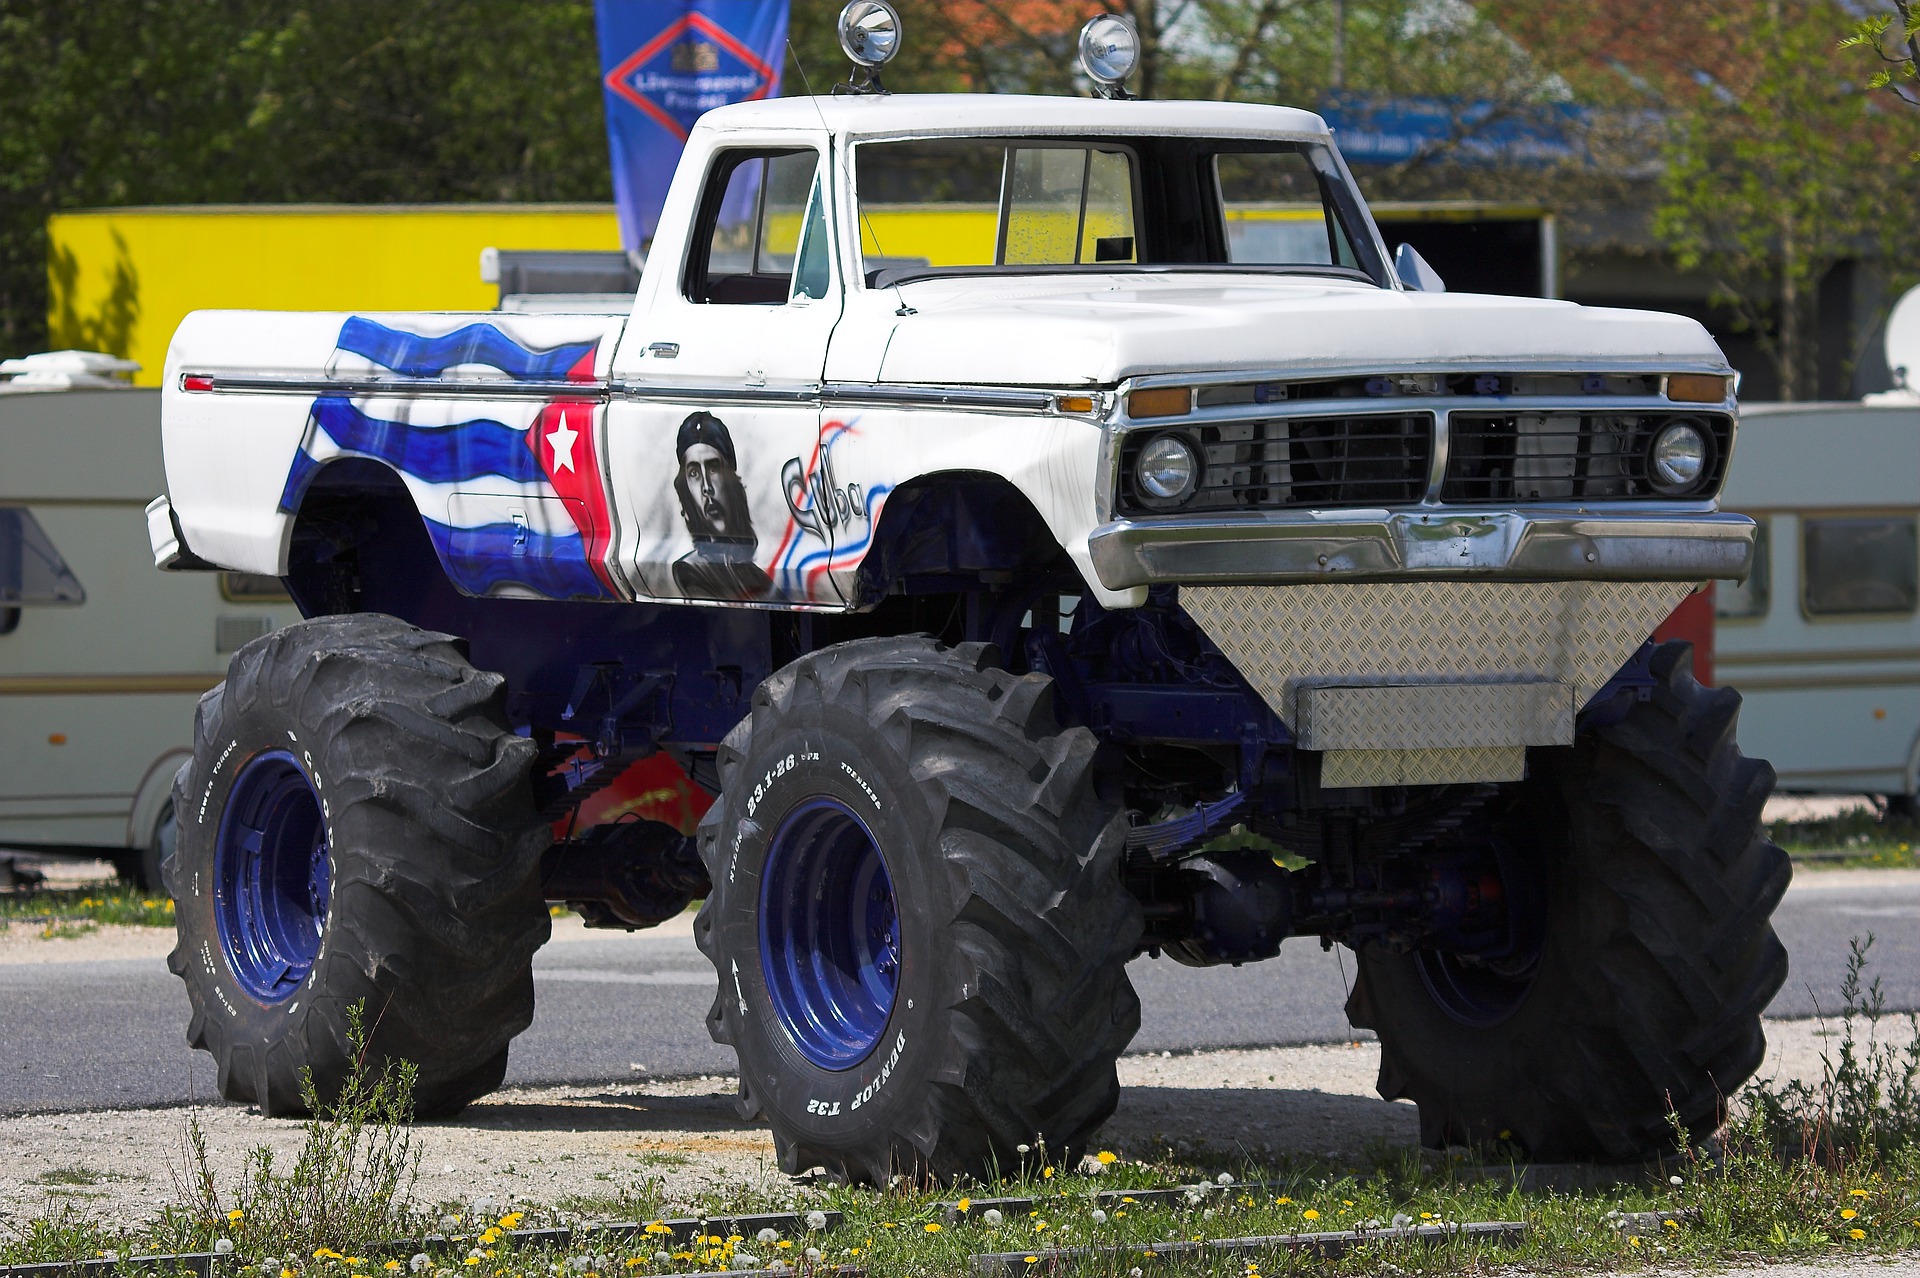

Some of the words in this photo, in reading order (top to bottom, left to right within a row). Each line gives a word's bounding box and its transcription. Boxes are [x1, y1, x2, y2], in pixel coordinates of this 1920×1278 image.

[780, 443, 868, 546] Cuba
[198, 780, 214, 824] POWER
[212, 739, 237, 775] TORQUE
[747, 753, 795, 817] 23.1-26
[806, 1098, 841, 1117] T32
[850, 1028, 906, 1111] DUNLOP
